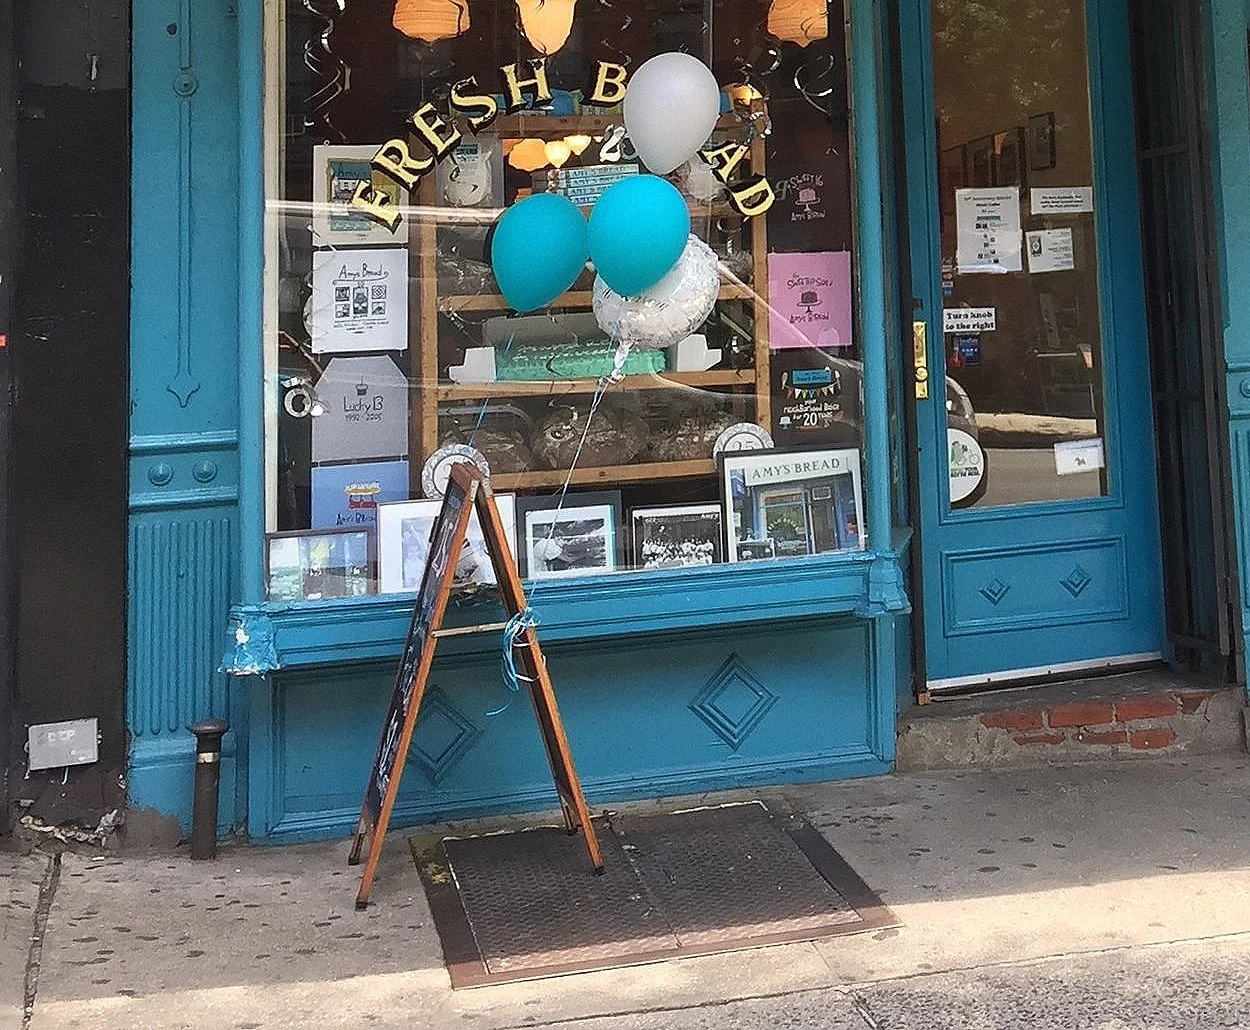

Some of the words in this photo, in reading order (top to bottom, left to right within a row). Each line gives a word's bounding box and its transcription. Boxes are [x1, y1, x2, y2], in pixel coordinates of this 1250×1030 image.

[348, 57, 553, 235] FRESH
[589, 59, 776, 217] BAD
[946, 312, 968, 320] Turn
[970, 311, 993, 319] knob
[956, 322, 971, 330] the
[972, 321, 994, 331] right
[343, 395, 371, 413] Lucky
[373, 395, 384, 411] 13
[803, 412, 818, 426] 20
[795, 458, 840, 473] BREAD
